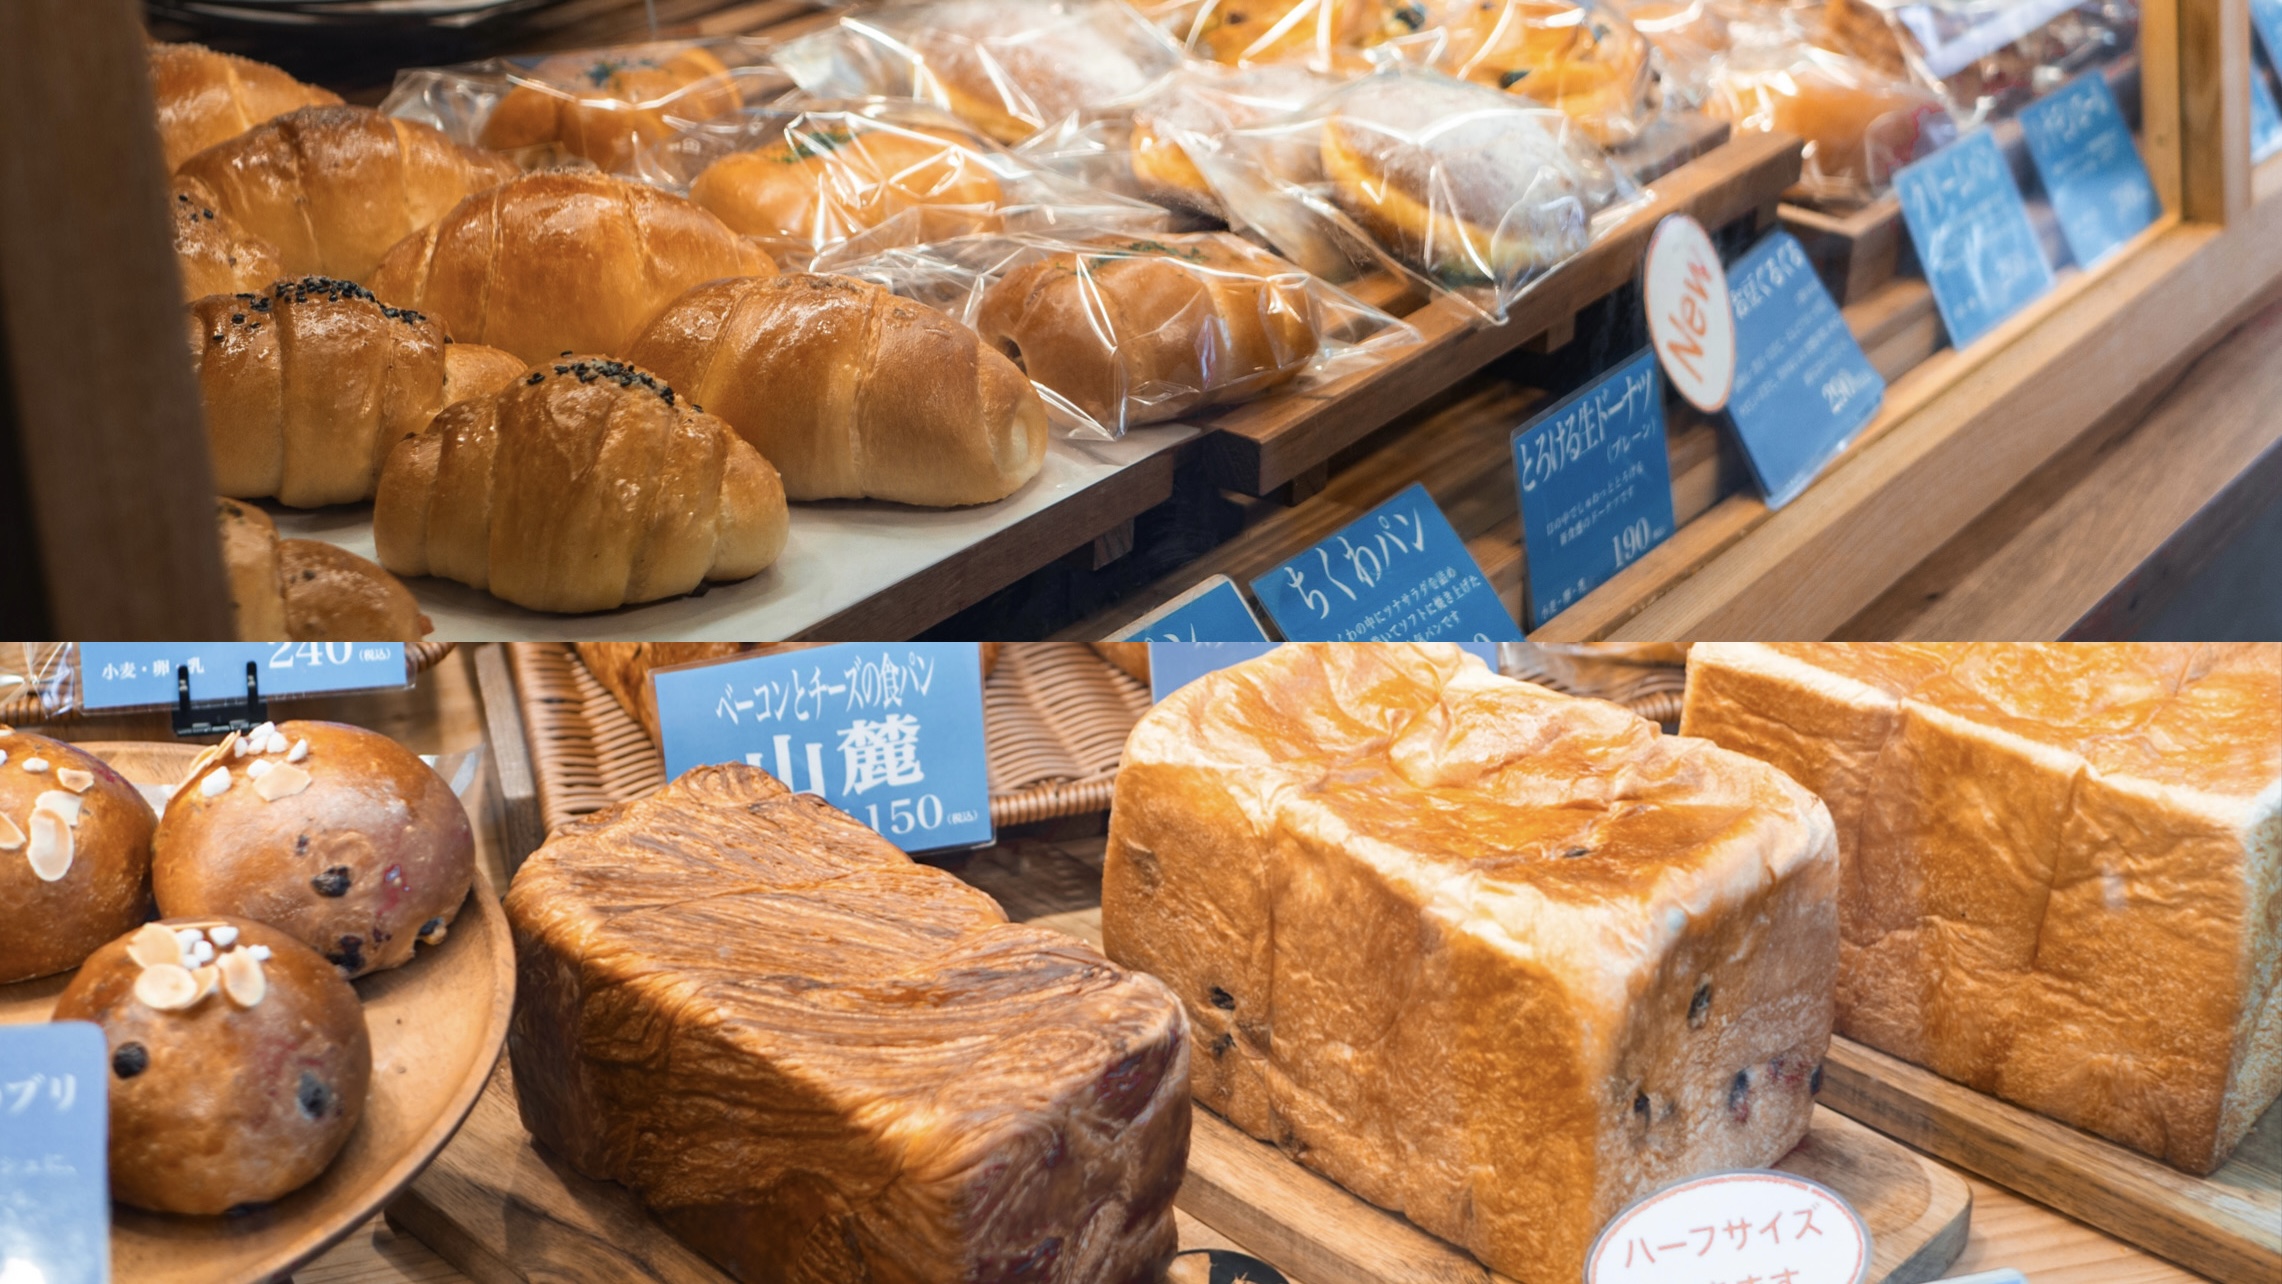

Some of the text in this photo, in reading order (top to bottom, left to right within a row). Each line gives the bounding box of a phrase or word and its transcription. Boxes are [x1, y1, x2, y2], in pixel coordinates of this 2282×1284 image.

[1666, 249, 1713, 384] New
[1520, 369, 1653, 492] とろける生ドーナツ
[1284, 506, 1426, 620] ちくわパン
[1612, 516, 1649, 568] 190
[1327, 566, 1457, 642] くわの中にツナサラダを詰め
[715, 651, 935, 725] ベーコンとチーズの食パン
[745, 713, 926, 798] 山麓
[1625, 1201, 1823, 1269] ハーフサイズ
